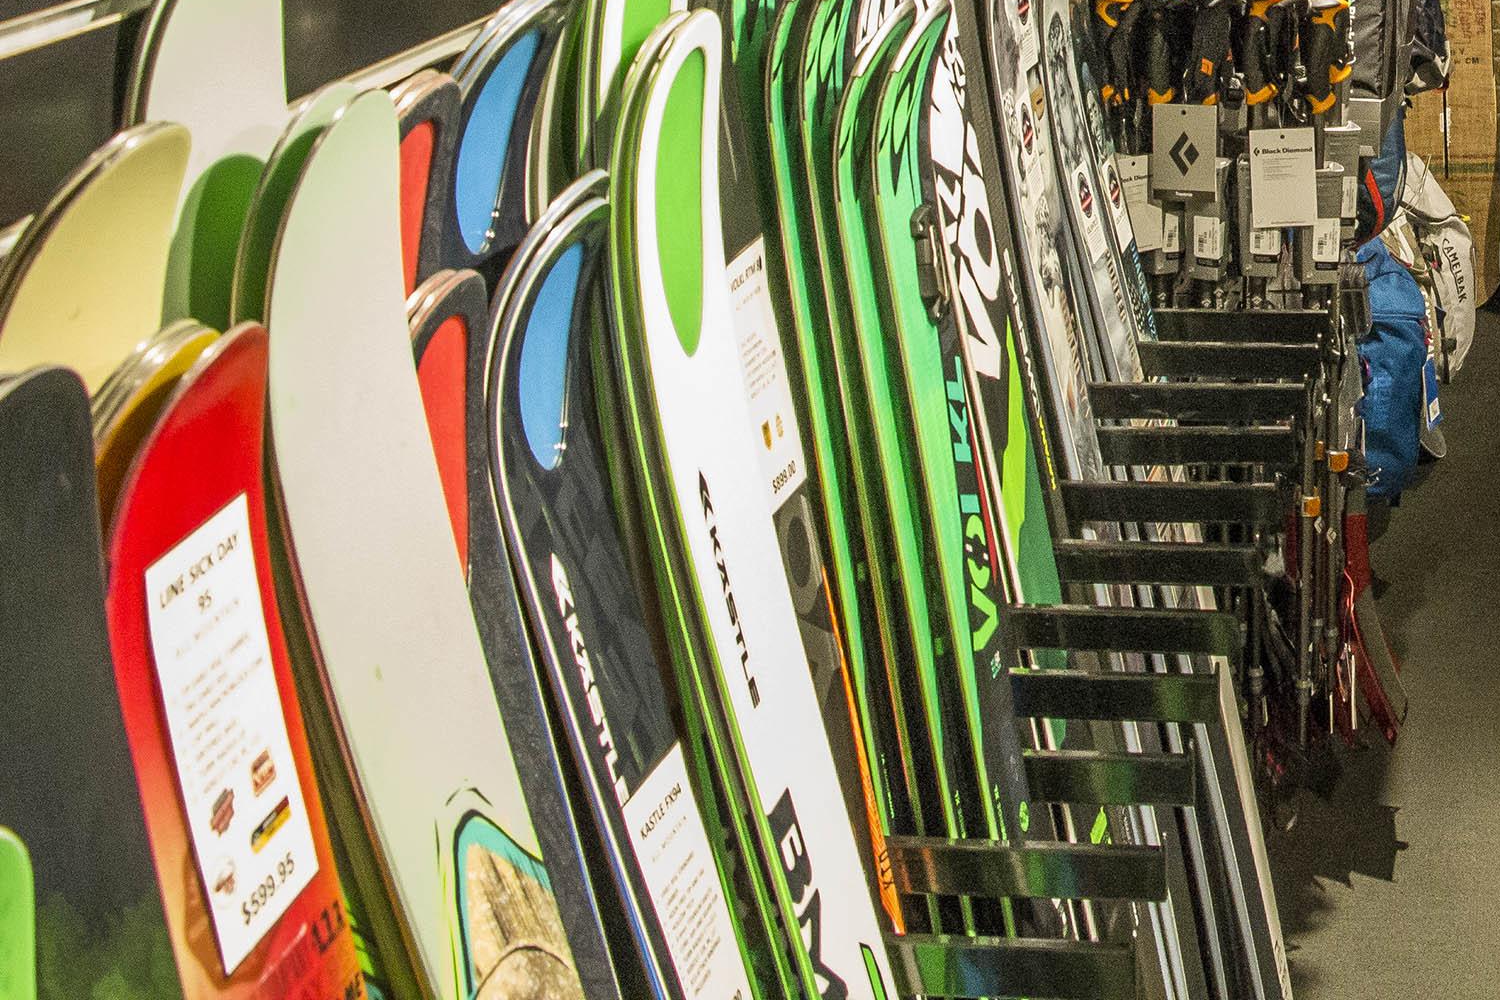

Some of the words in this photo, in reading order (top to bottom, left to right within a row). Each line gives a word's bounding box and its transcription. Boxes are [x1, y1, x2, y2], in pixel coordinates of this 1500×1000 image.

[1262, 147, 1281, 155] Black
[1282, 146, 1313, 154] Diamond
[1442, 238, 1469, 304] CAMELBAK
[160, 576, 184, 609] LINE
[188, 553, 214, 585] SICK
[218, 533, 238, 561] DAY
[198, 589, 213, 612] 95
[640, 805, 667, 840] KASTLE
[241, 851, 295, 925] $599.95
